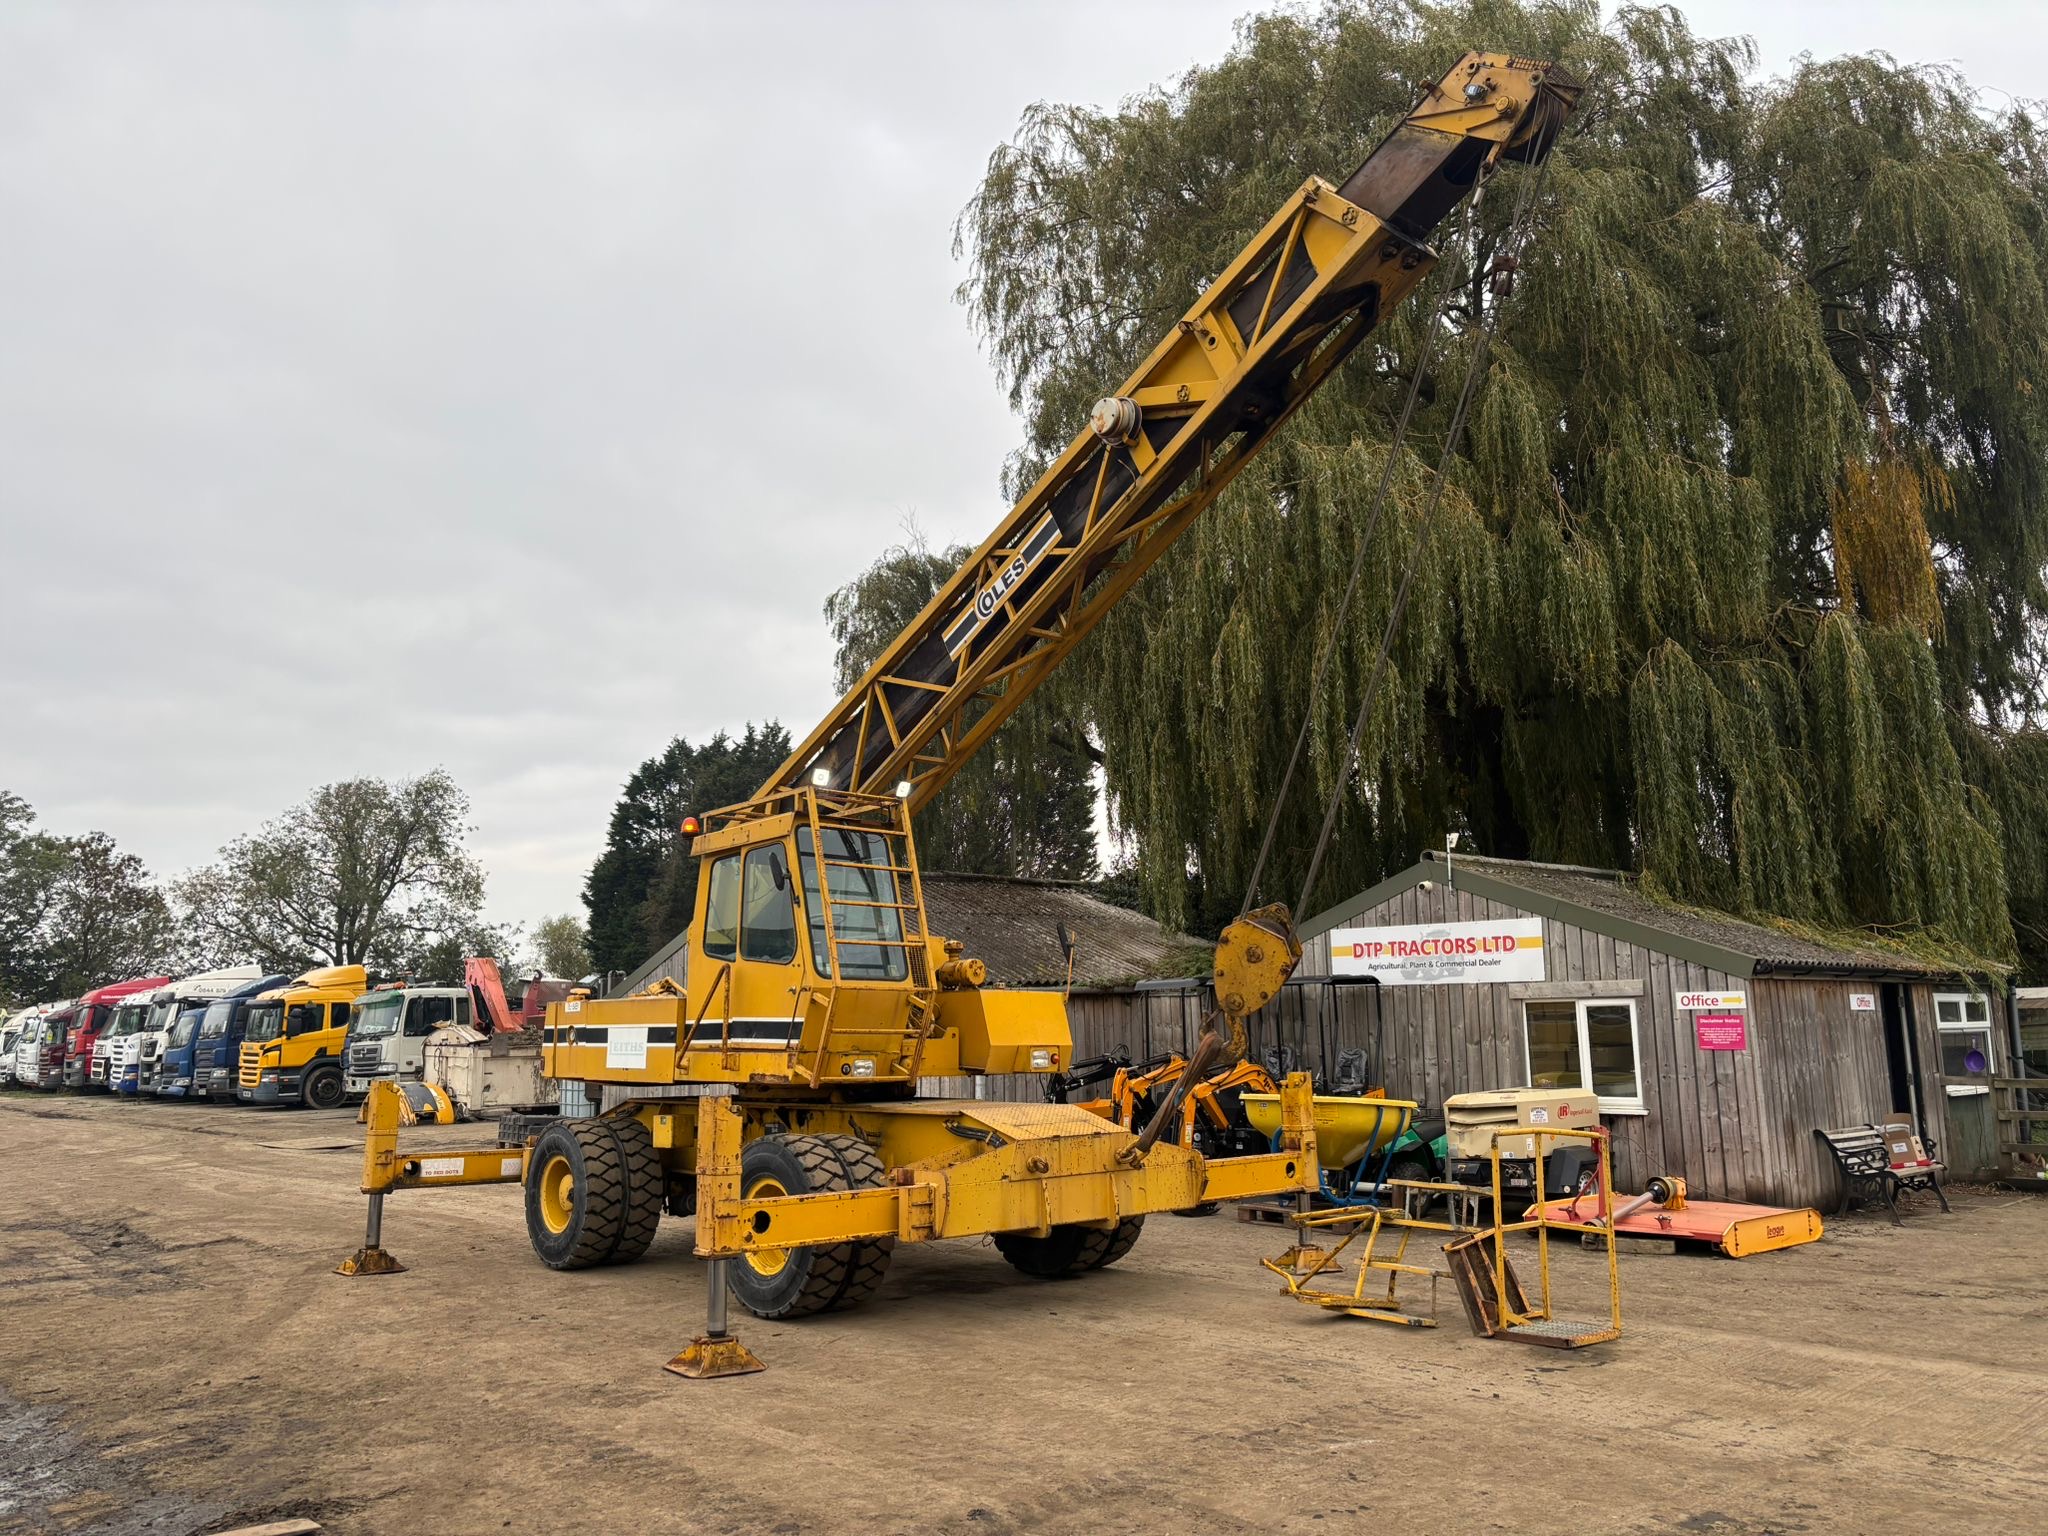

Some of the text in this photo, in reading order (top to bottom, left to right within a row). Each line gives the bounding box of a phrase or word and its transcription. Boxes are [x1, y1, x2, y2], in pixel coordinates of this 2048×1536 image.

[976, 557, 1026, 618] COLES
[1352, 935, 1516, 958] DTP TRACTORS LTD
[1410, 961, 1427, 969] Plant
[1435, 959, 1477, 968] Commercial
[1479, 958, 1501, 967] Dealer
[1681, 995, 1719, 1007] Office
